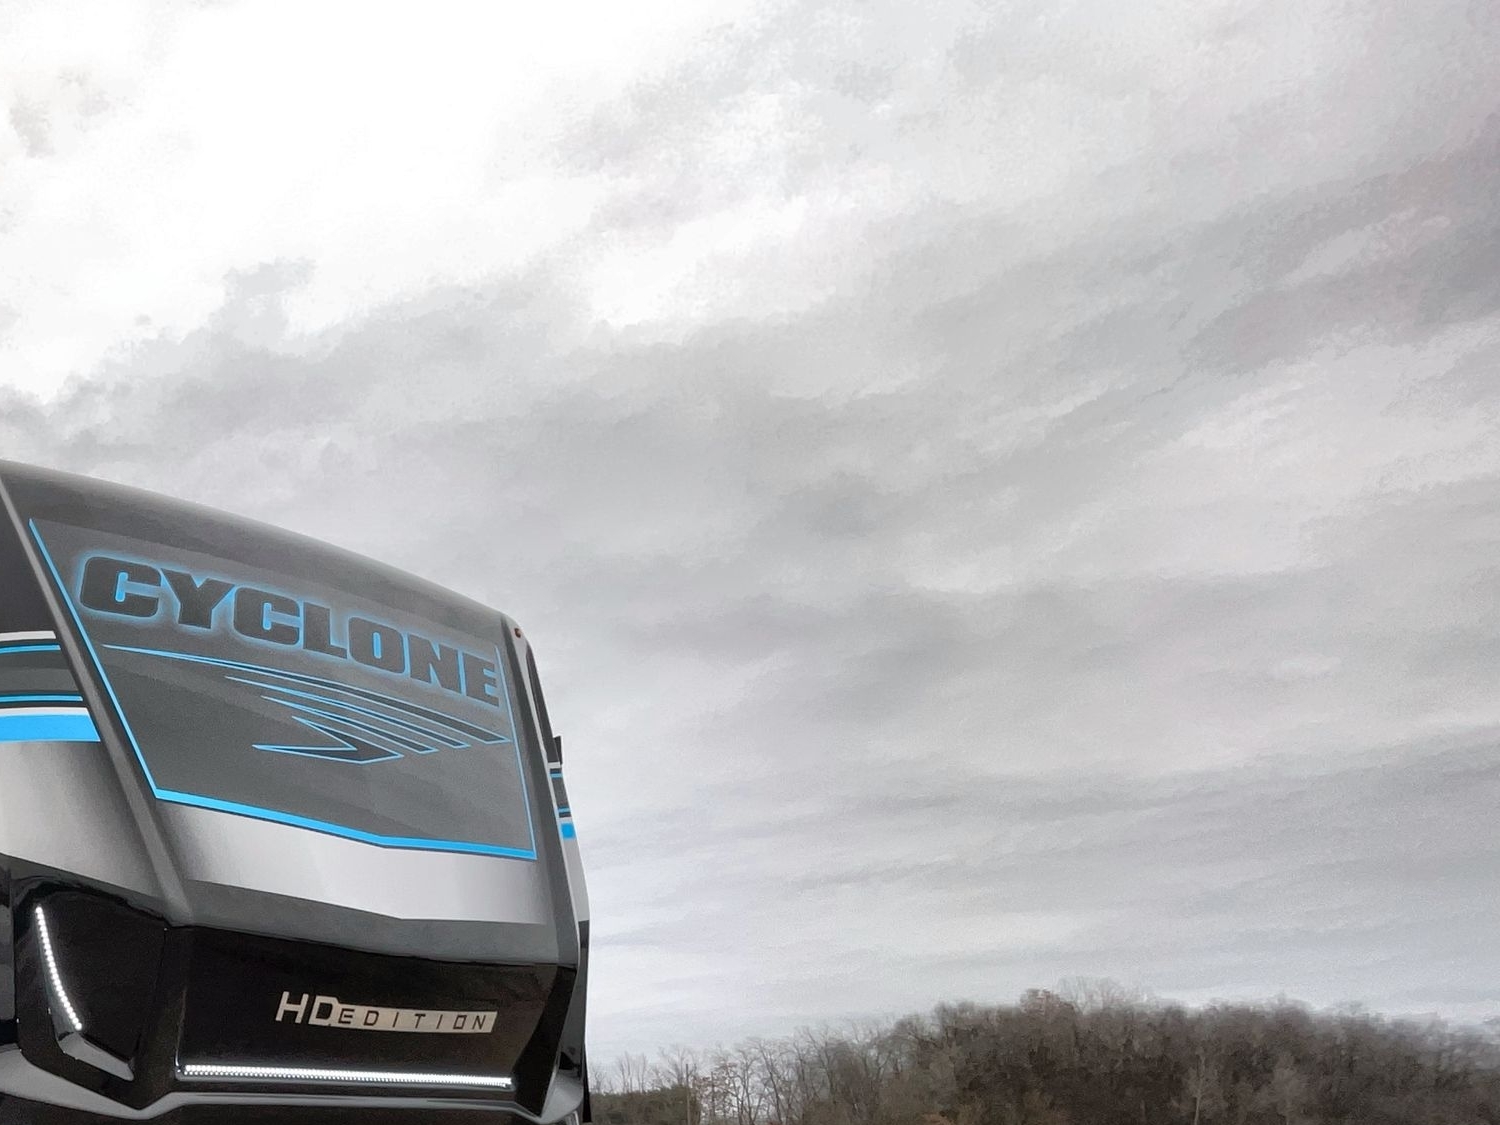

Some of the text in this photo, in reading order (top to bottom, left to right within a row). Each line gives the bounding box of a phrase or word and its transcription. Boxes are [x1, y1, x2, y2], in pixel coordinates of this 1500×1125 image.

[77, 555, 501, 708] CYCLONE
[275, 990, 487, 1030] HD EDITION
